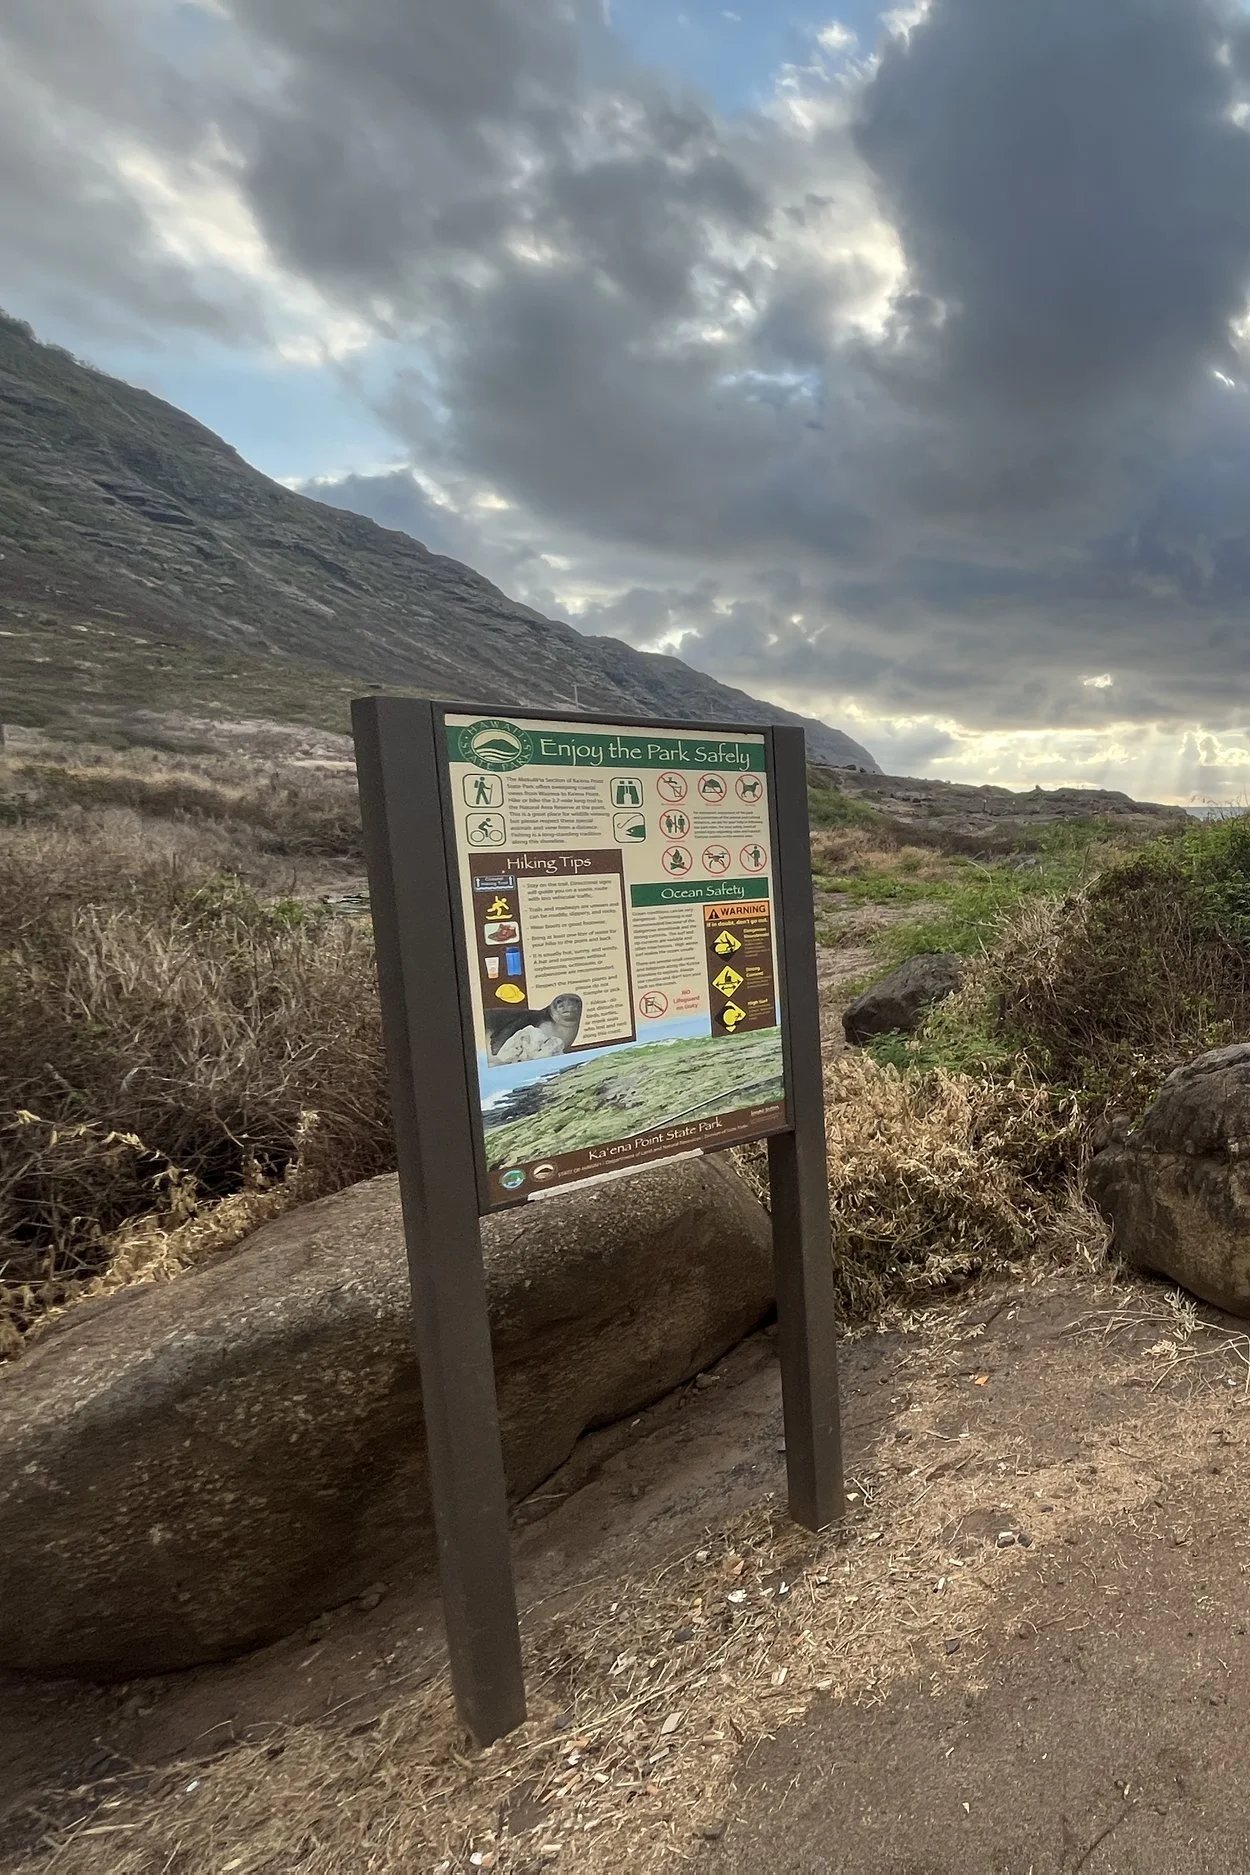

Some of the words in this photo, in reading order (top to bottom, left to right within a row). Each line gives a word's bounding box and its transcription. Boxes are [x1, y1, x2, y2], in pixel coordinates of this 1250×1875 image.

[540, 737, 604, 766] Enjoy
[608, 736, 642, 760] the
[647, 740, 691, 763] Park
[694, 742, 751, 771] Safely
[507, 853, 558, 874] Hiking
[558, 855, 592, 874] Tips
[661, 887, 703, 899] Ocean
[706, 881, 745, 899] Safety
[721, 904, 766, 916] WARNING
[634, 1132, 664, 1150] Point
[665, 1125, 697, 1142] State
[698, 1116, 723, 1132] Park
